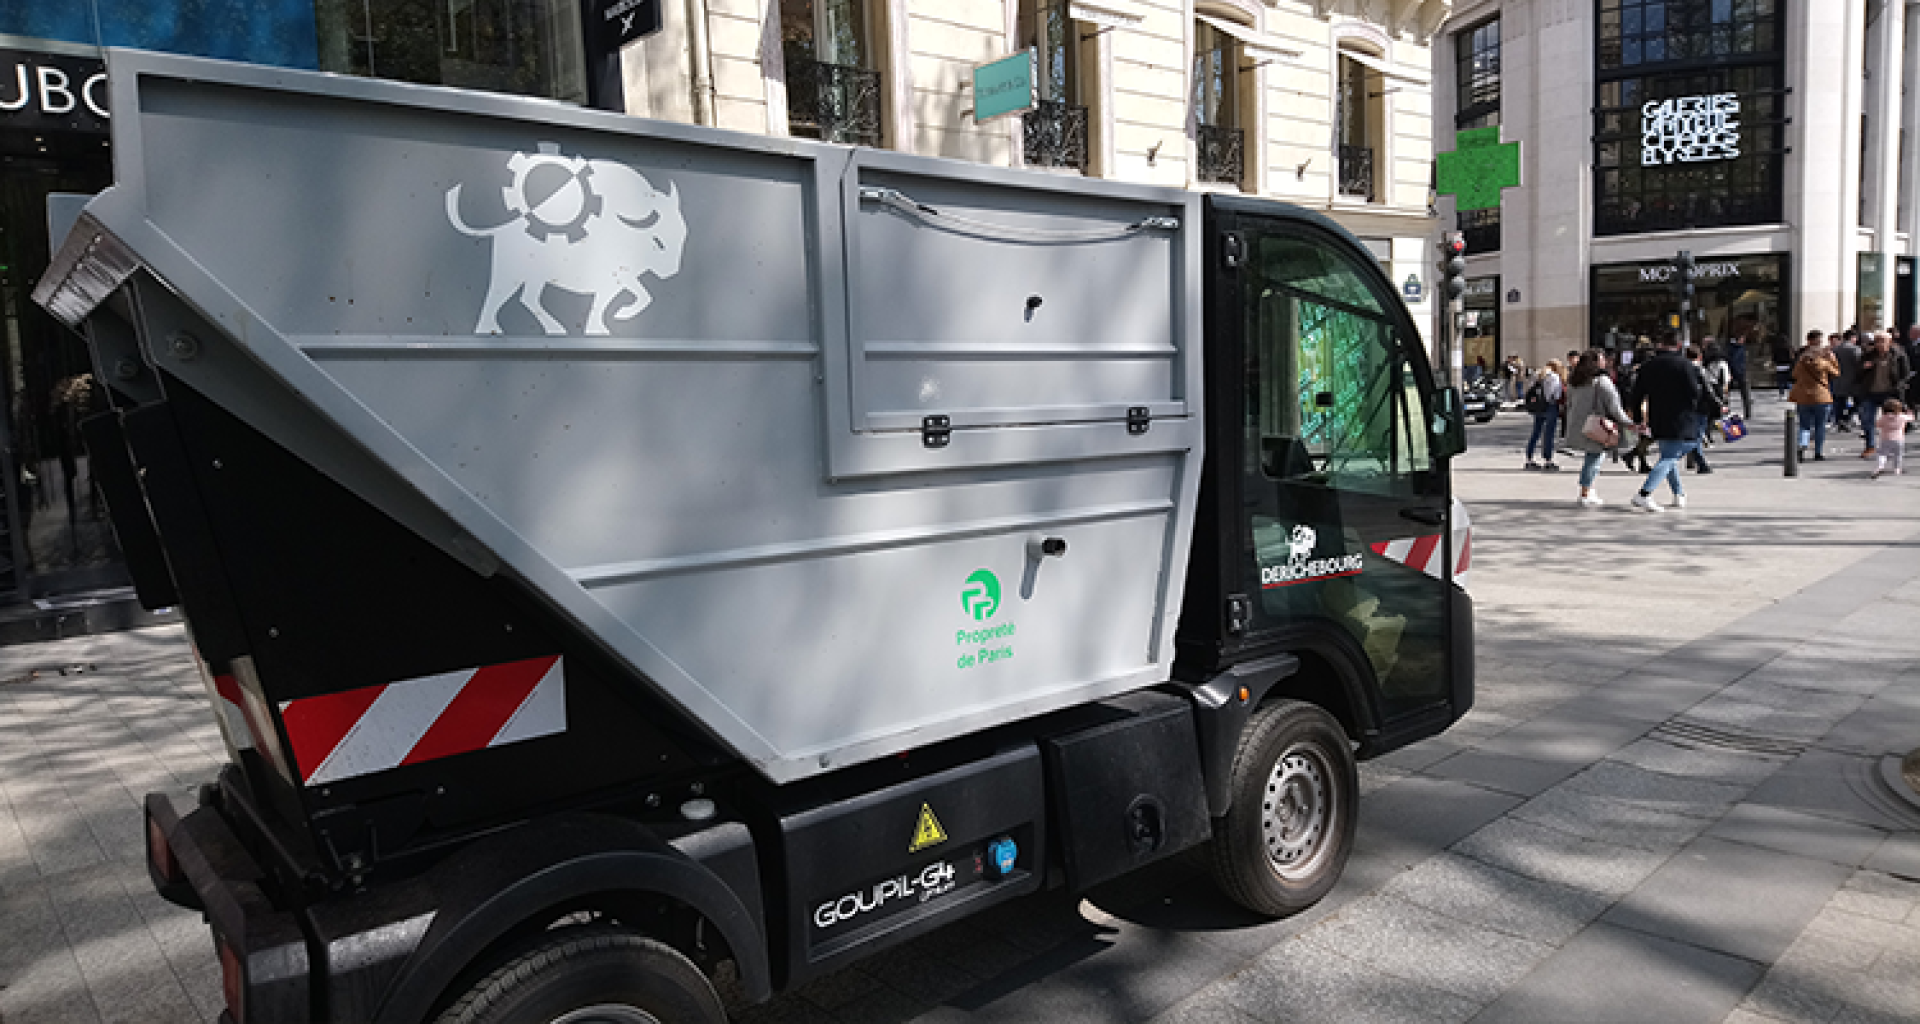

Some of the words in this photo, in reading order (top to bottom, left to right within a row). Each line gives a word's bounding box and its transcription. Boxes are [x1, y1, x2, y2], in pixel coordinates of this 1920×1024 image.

[1261, 553, 1362, 584] DERICHEBOURG
[957, 620, 1016, 646] Propreté
[957, 653, 975, 669] de
[978, 645, 1014, 664] Paris
